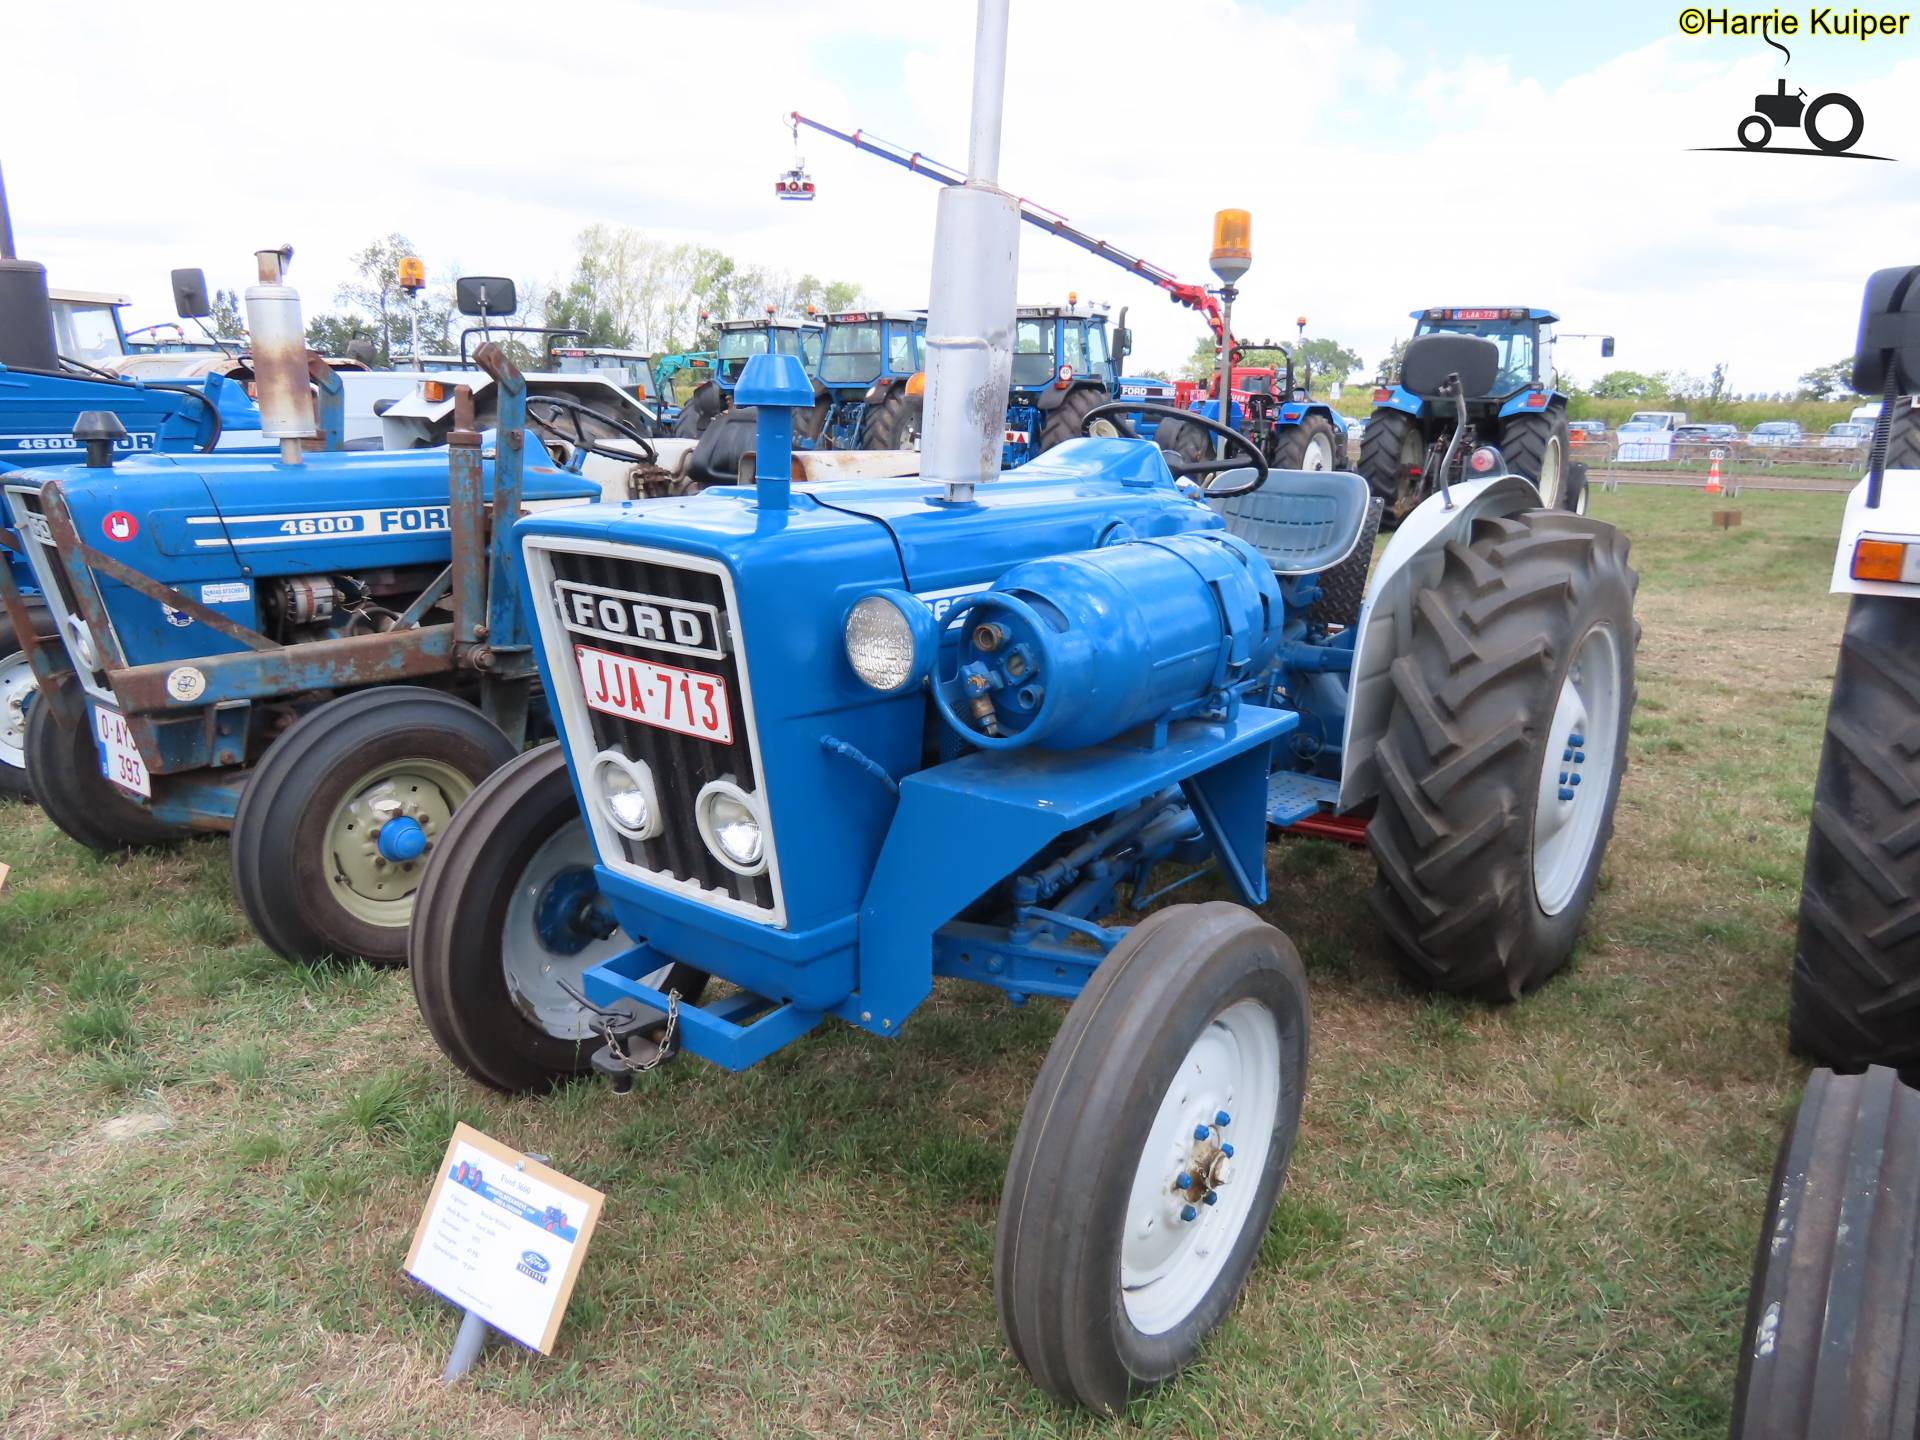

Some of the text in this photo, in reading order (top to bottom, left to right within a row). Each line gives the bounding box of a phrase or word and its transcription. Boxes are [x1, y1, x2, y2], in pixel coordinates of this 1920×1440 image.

[1122, 387, 1147, 396] FORD
[18, 438, 77, 449] 4600
[280, 508, 450, 535] 4600 FOR
[571, 593, 704, 646] FORD
[118, 754, 141, 786] 393
